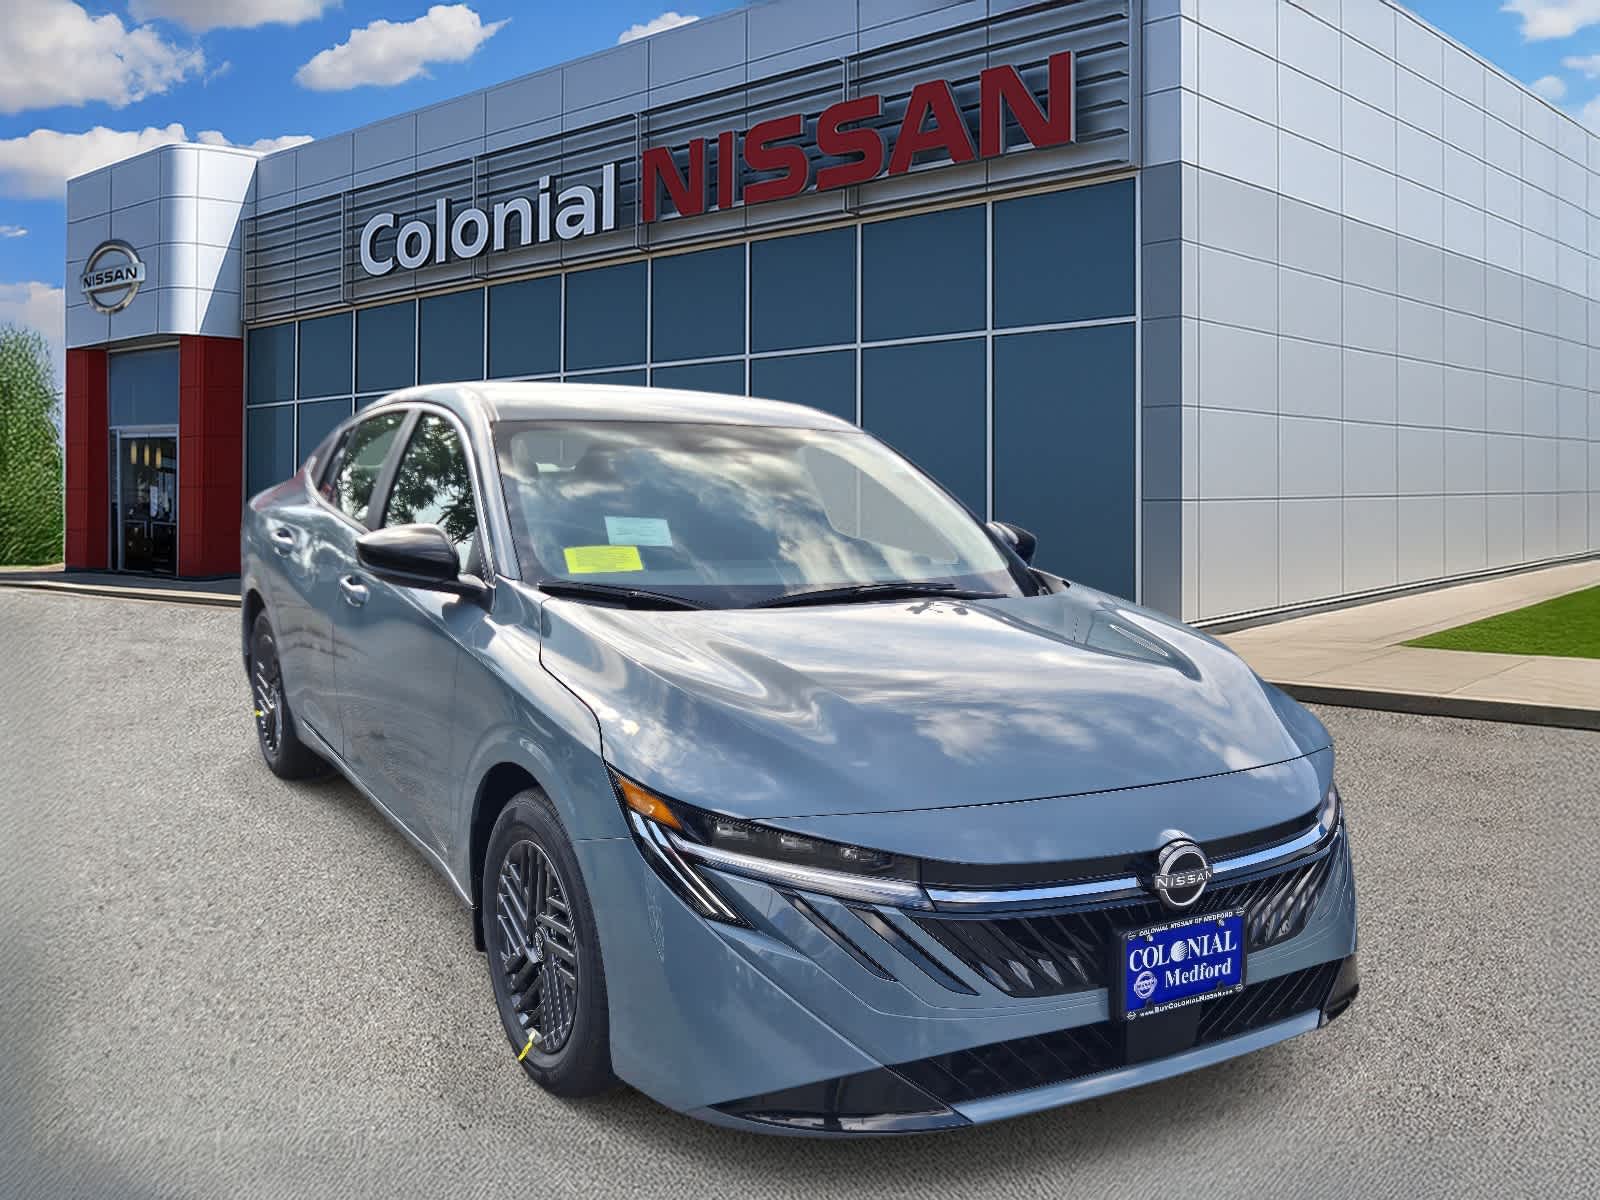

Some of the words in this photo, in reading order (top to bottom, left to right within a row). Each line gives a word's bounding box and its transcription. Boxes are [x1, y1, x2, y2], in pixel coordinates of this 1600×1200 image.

[359, 162, 618, 277] Colonial
[639, 50, 1077, 223] NISSAN
[83, 266, 137, 288] NISSAN
[1156, 870, 1212, 888] NISSAN
[1165, 958, 1231, 988] Medford
